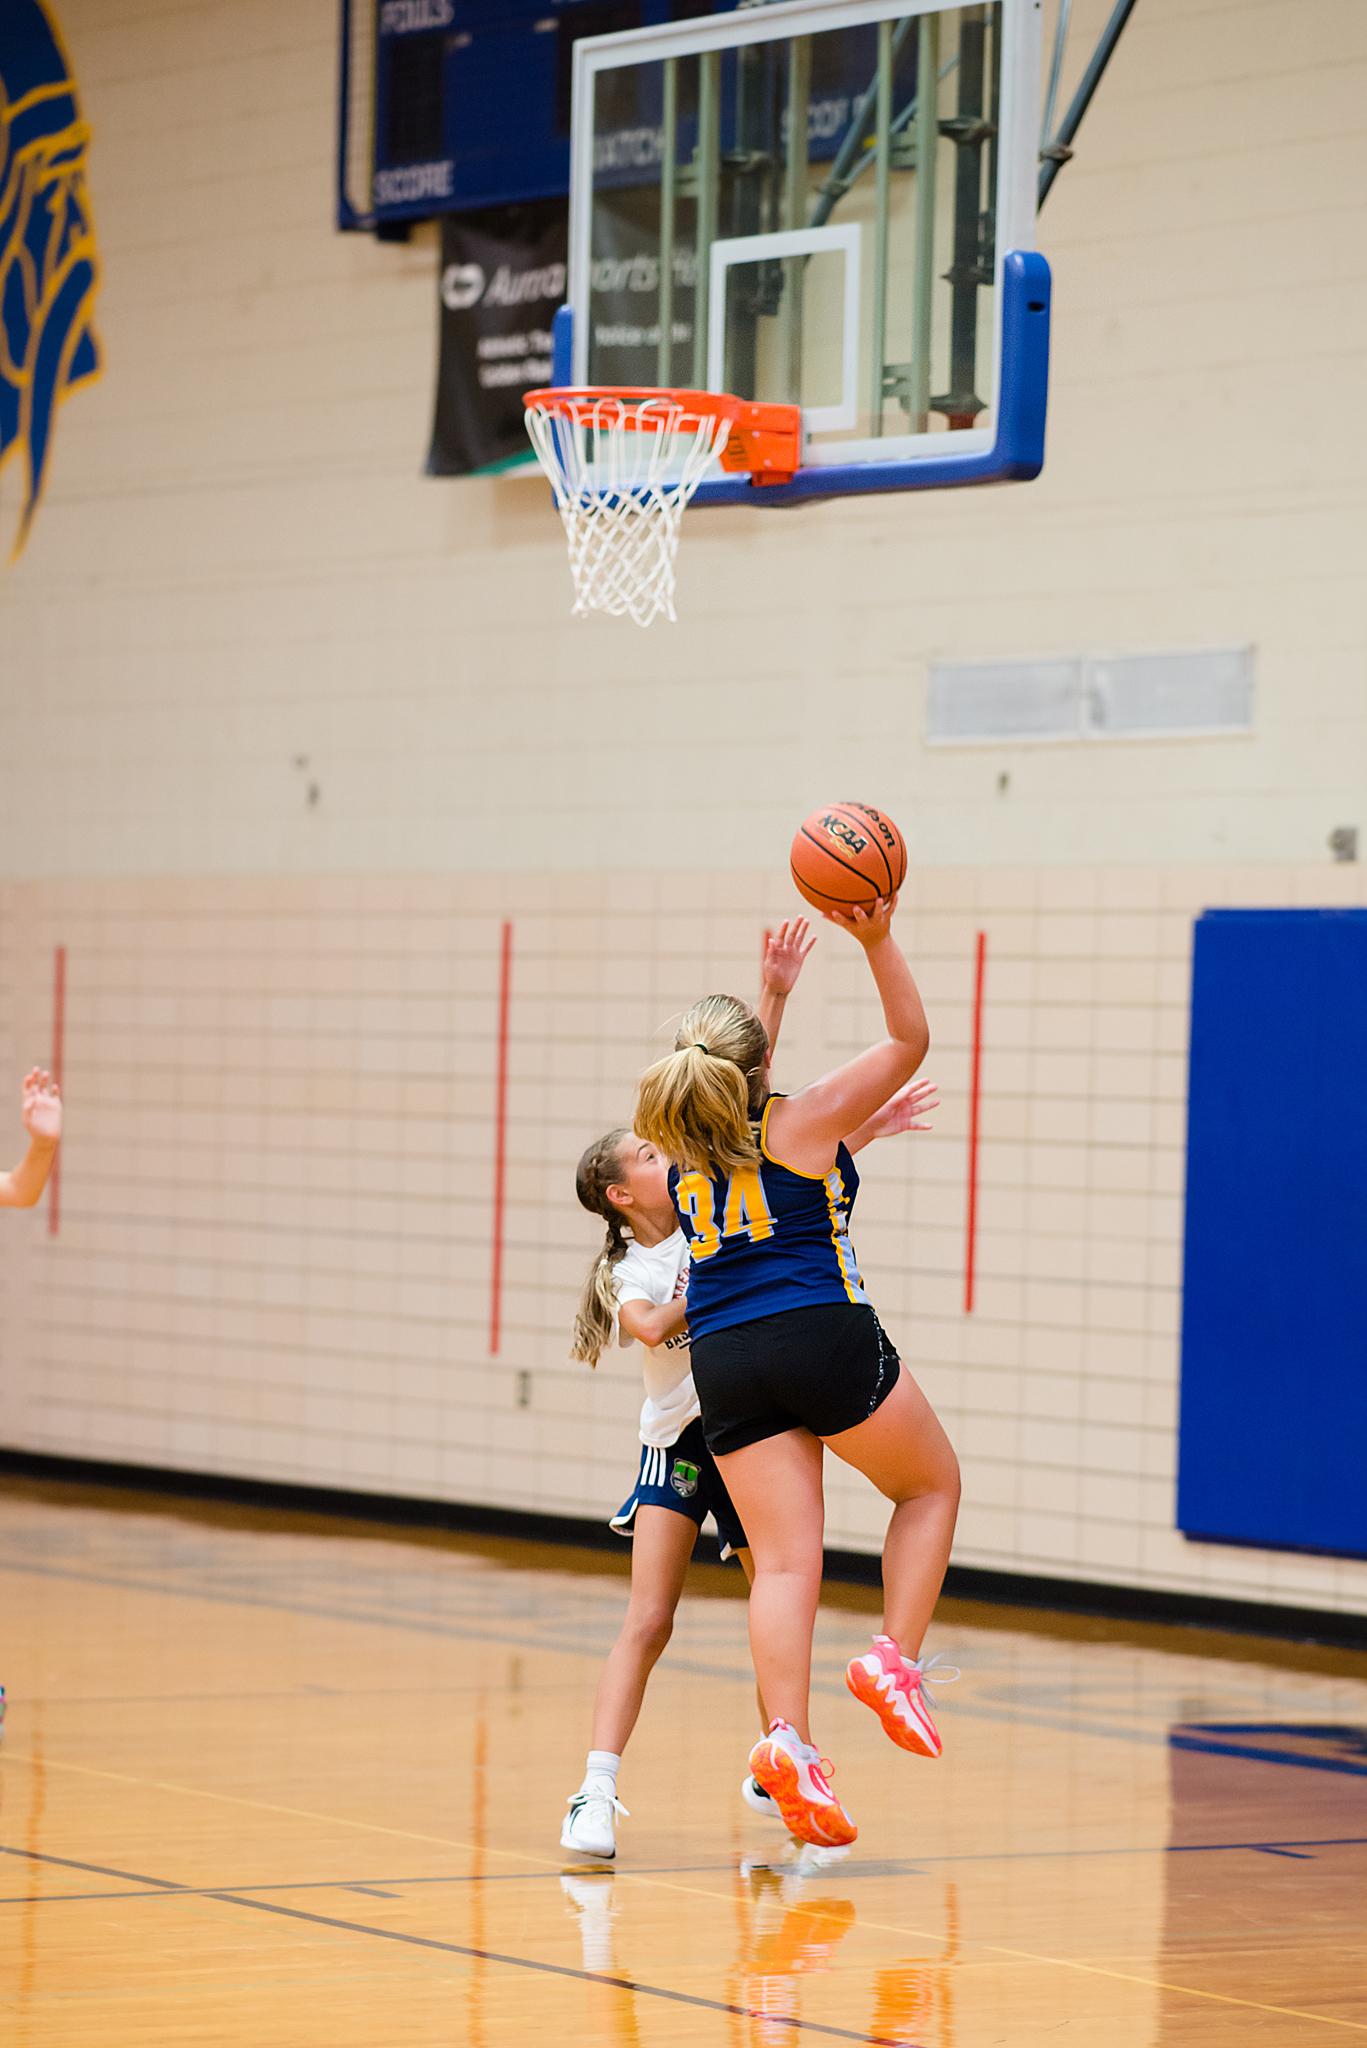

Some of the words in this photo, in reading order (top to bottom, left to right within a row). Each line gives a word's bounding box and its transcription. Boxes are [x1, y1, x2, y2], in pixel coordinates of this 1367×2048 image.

[374, 160, 455, 206] SCORE
[817, 814, 869, 855] NCAA
[674, 1166, 779, 1263] 34
